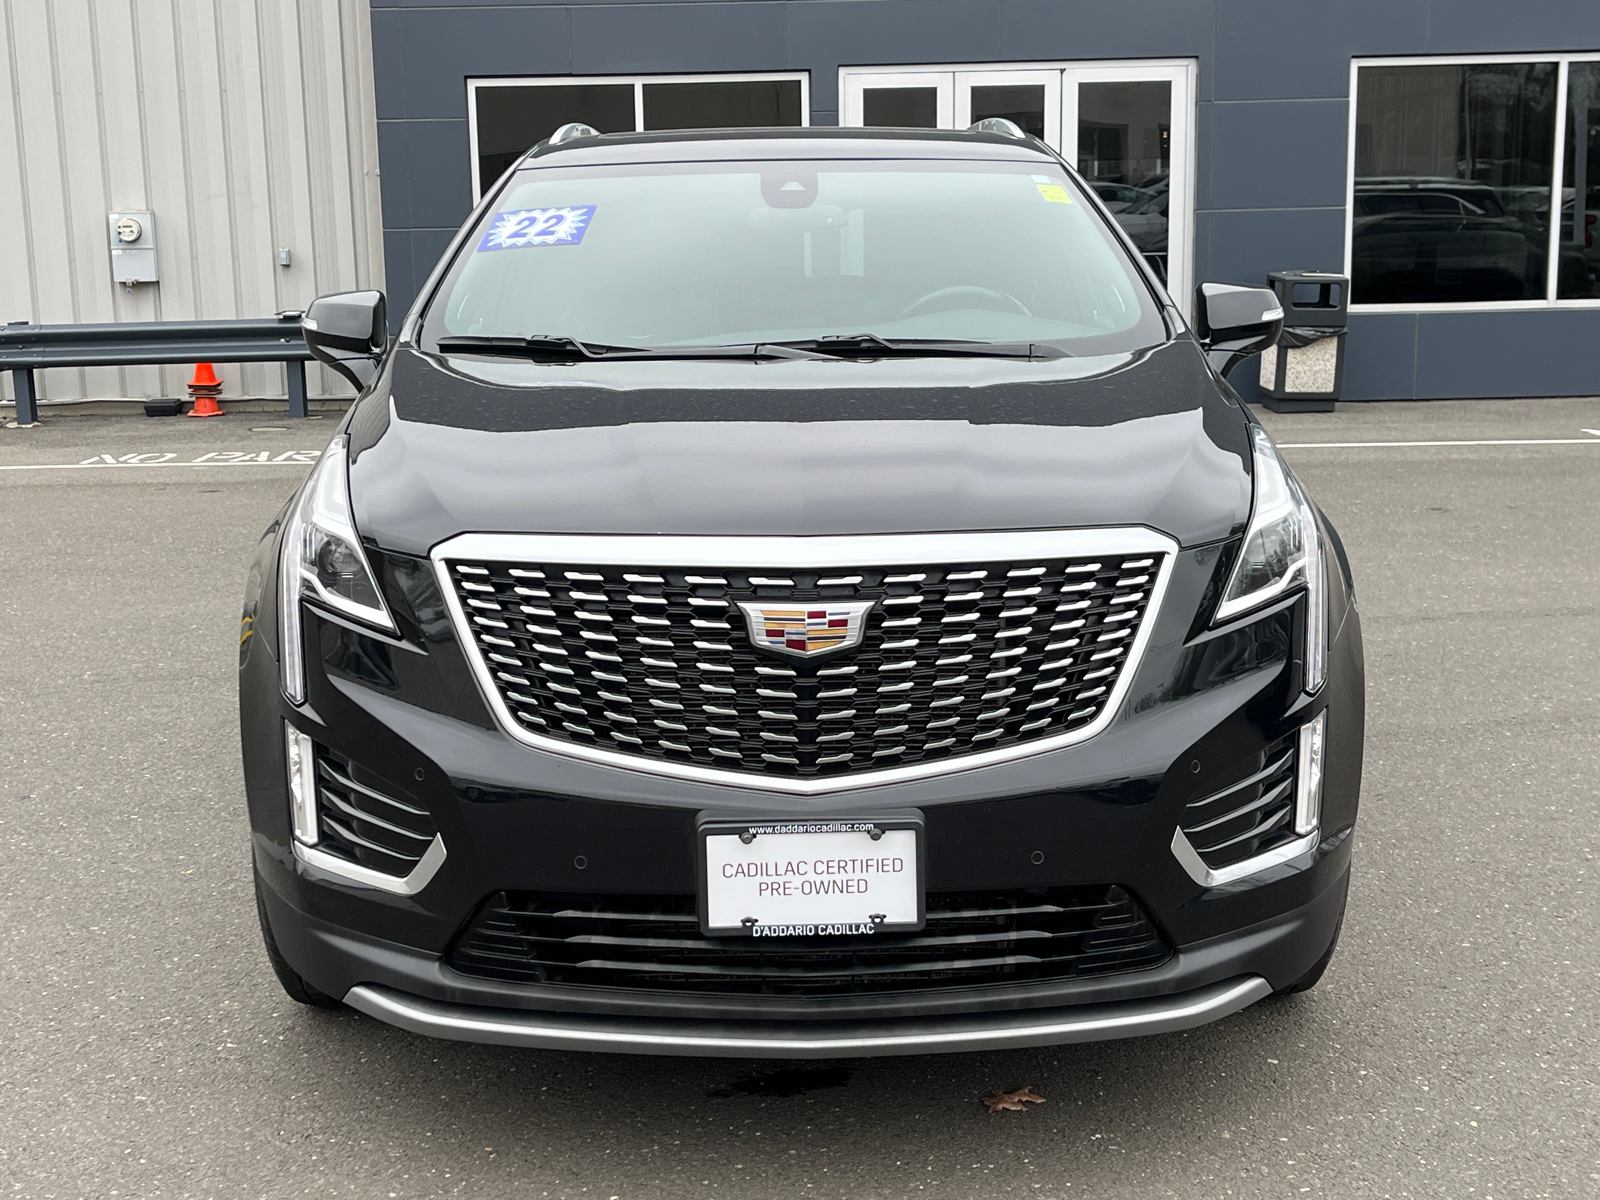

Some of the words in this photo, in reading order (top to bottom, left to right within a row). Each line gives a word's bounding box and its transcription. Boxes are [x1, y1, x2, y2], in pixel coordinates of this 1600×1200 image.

[505, 214, 566, 239] 22
[79, 452, 177, 464] NO
[749, 823, 874, 834] www.daddariocadillac.com
[722, 860, 808, 879] CADILLAC
[813, 857, 904, 875] CERTIFIED
[758, 878, 868, 896] PRE-OWNED
[752, 925, 815, 937] D'ADDARIO
[818, 923, 875, 936] CADILLAC
